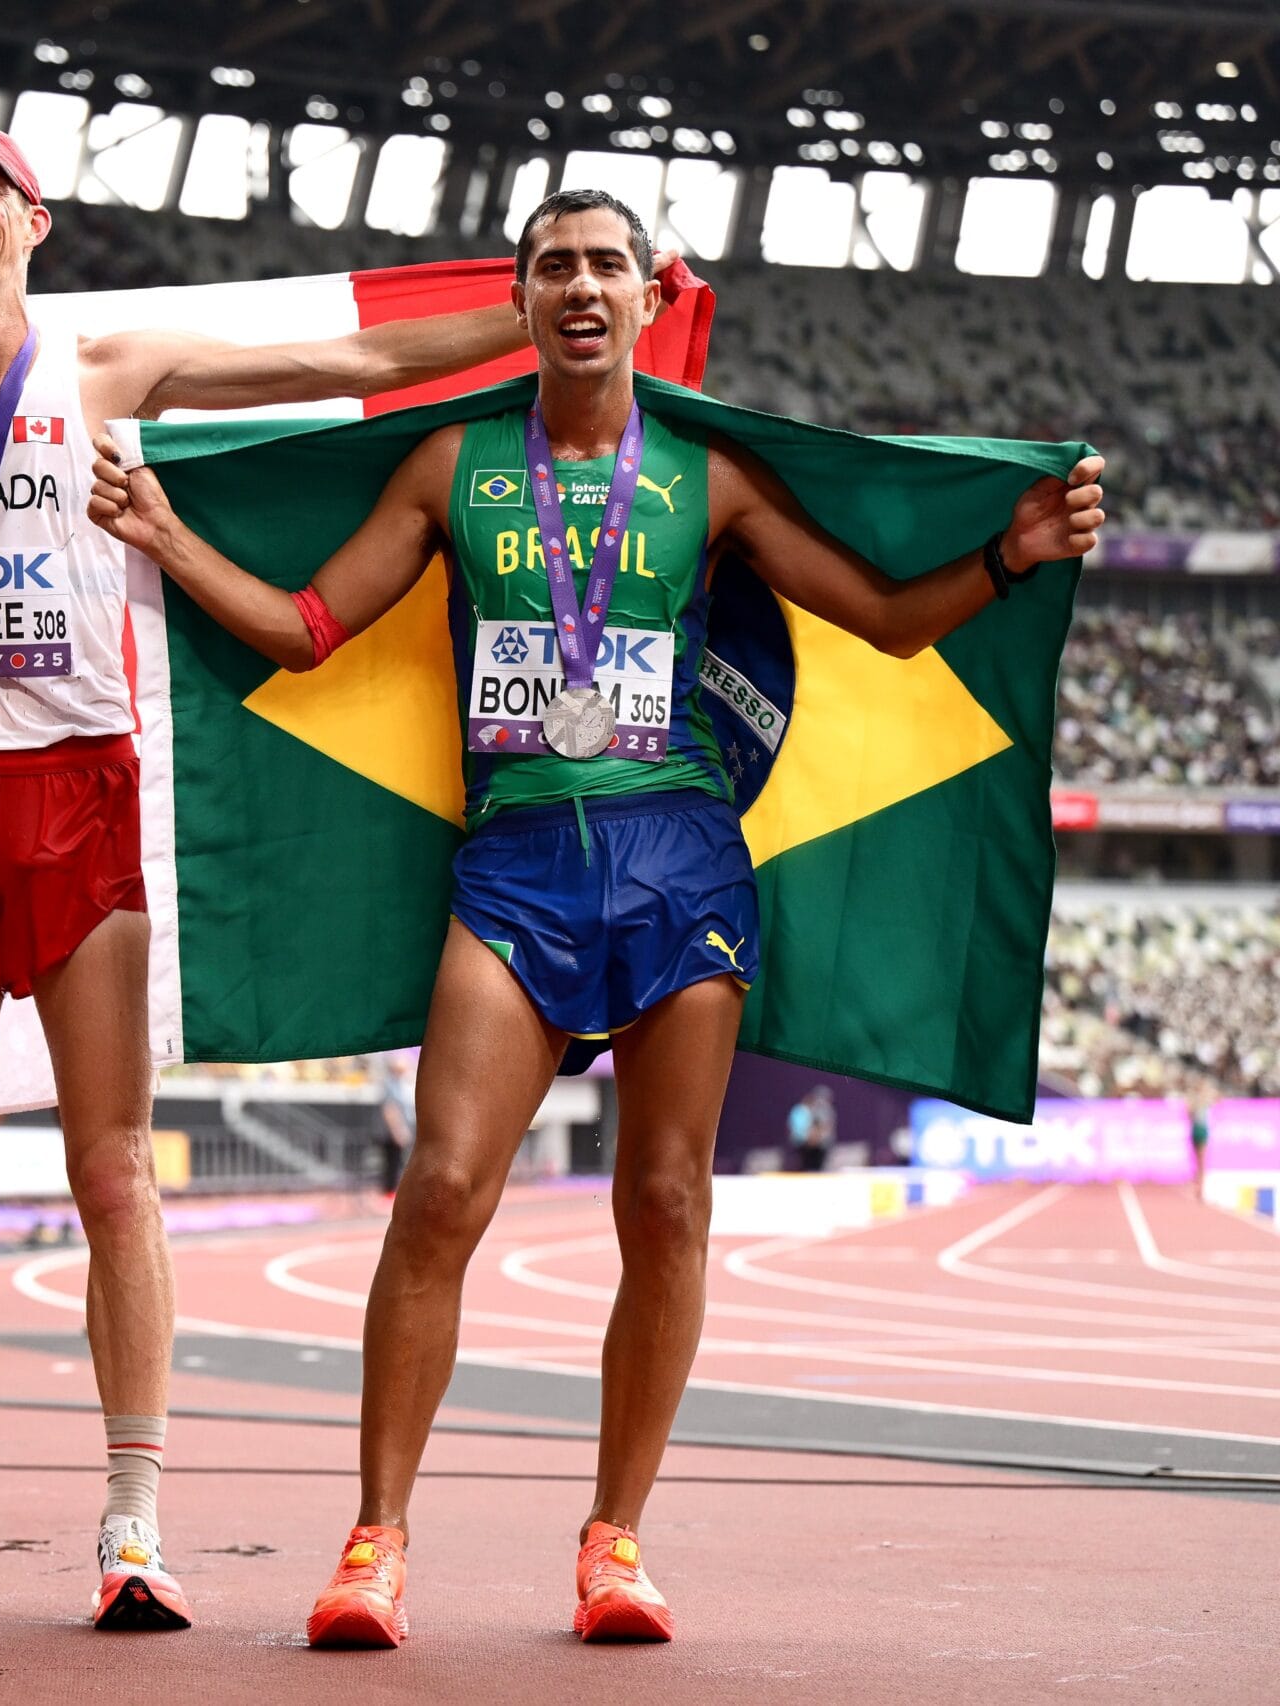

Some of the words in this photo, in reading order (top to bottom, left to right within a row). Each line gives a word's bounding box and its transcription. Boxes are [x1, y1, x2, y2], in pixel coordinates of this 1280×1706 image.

[571, 482, 611, 493] loteri
[571, 493, 608, 505] CAIX
[33, 609, 67, 640] 308
[33, 652, 64, 667] 25
[478, 676, 622, 719] BONM
[630, 693, 667, 725] 305
[626, 734, 658, 752] 25
